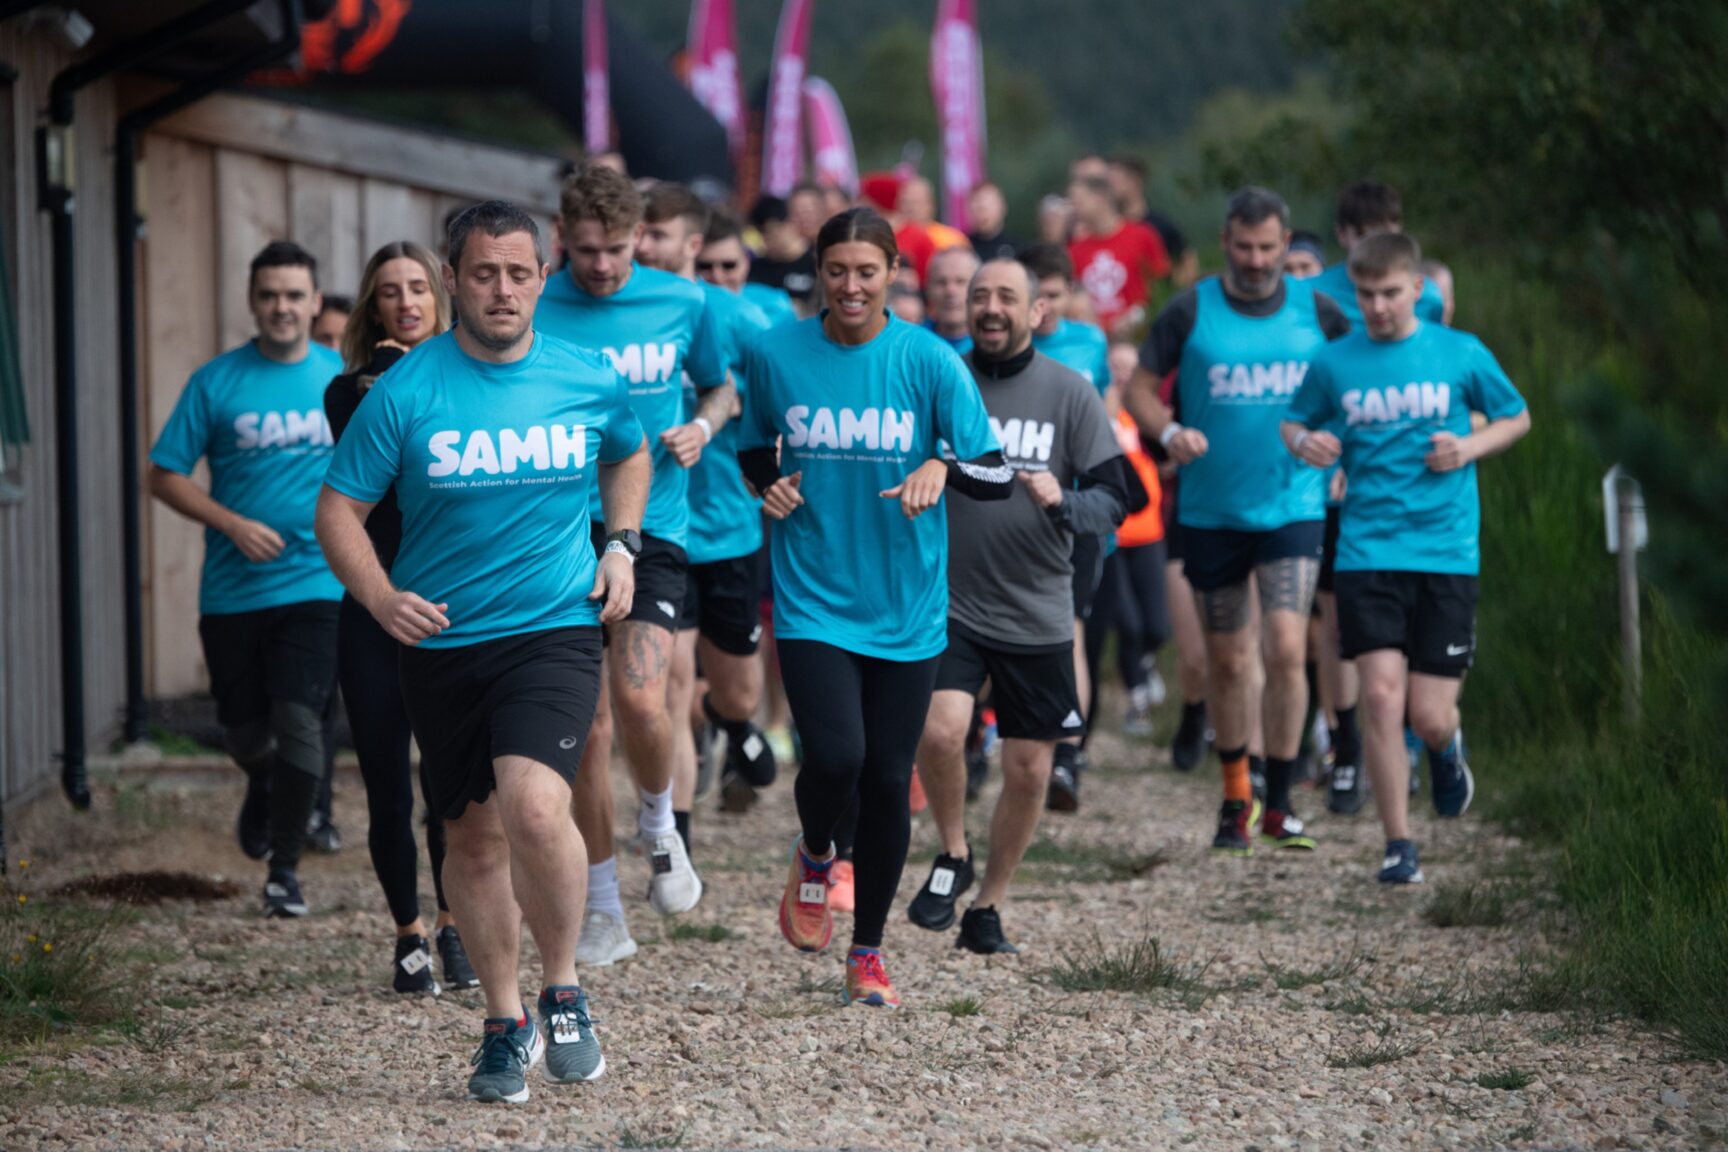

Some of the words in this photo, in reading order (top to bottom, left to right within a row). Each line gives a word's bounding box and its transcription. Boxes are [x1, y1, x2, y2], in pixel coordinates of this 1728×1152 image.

[600, 342, 677, 384] MH
[1341, 382, 1450, 426] SAMH
[427, 424, 587, 477] SAMH
[785, 405, 915, 453] SAMH
[988, 416, 1055, 462] MH
[429, 481, 467, 489] Scottish
[470, 478, 503, 488] Action
[505, 477, 520, 486] for
[522, 475, 556, 485] Mental
